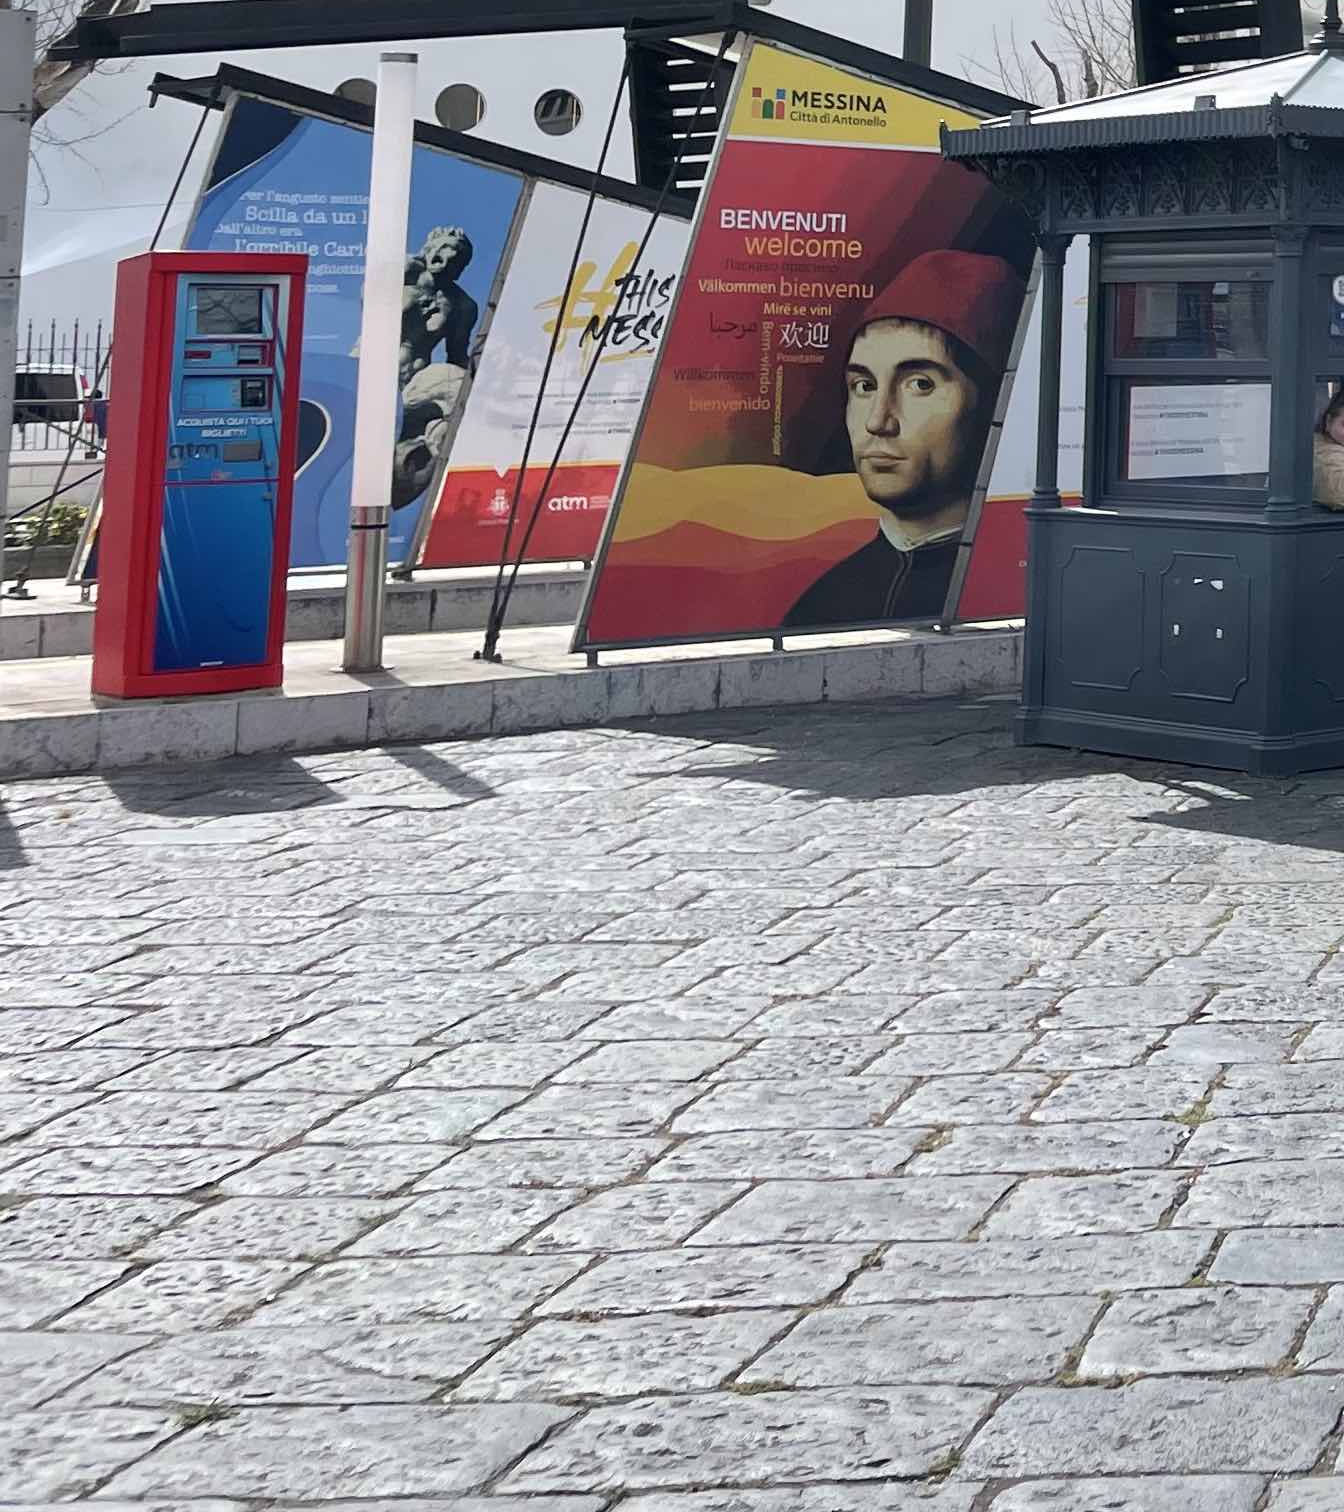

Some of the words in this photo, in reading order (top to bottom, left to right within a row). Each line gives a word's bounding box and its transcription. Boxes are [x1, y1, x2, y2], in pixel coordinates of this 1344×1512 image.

[792, 89, 887, 114] MESSINA
[790, 110, 818, 124] Città
[819, 113, 831, 124] di
[831, 114, 887, 128] Antonello
[245, 205, 299, 223] Scilla
[303, 208, 328, 224] da
[332, 212, 357, 224] un
[720, 208, 847, 233] BENVENUTI
[324, 242, 367, 257] Cari
[744, 232, 863, 259] welcome
[614, 268, 676, 310] THIS
[698, 277, 777, 294] Välkommen
[779, 275, 874, 299] bienvenu
[792, 306, 808, 316] se
[709, 311, 758, 339] مرحبا
[778, 320, 830, 349] 欢迎
[759, 320, 774, 395] Bem-vindo
[688, 395, 771, 414] bienvenido
[548, 494, 588, 512] atm
